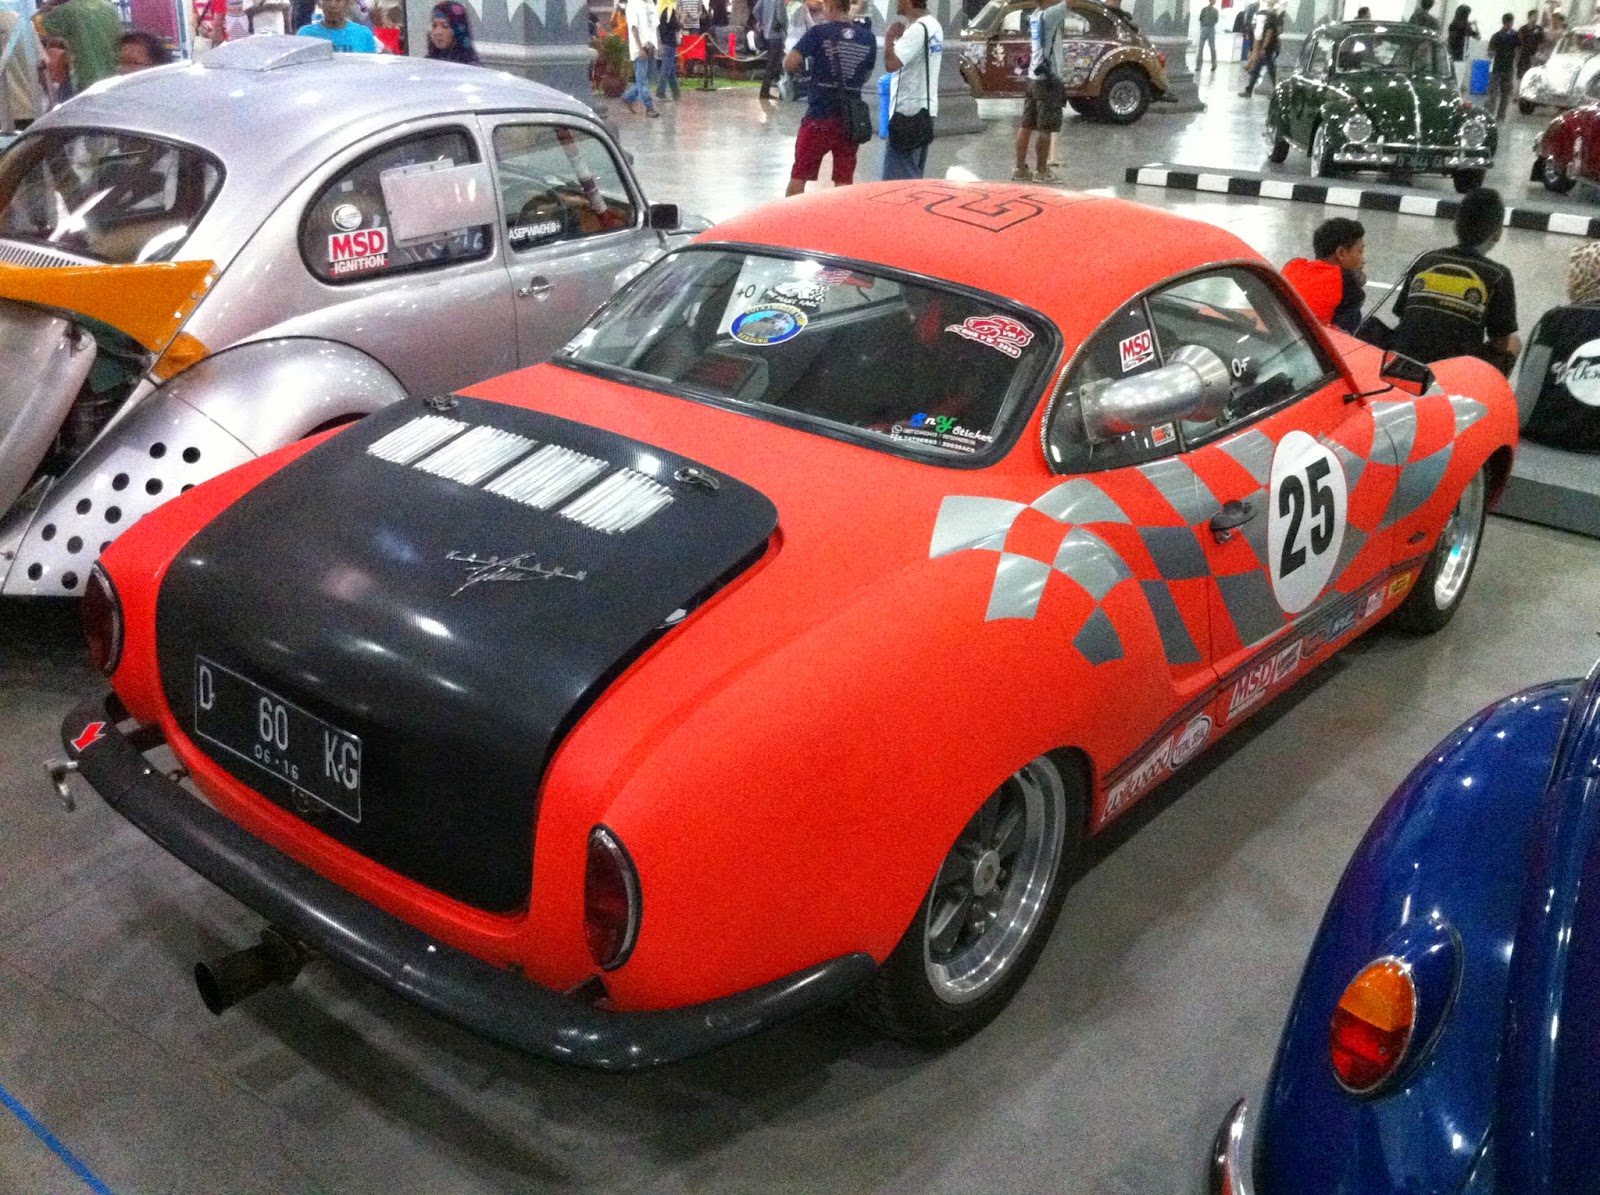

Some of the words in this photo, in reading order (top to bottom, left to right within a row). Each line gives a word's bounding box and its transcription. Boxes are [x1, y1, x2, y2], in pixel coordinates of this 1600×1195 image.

[332, 230, 385, 261] MSD
[334, 254, 385, 275] IGNITION
[1122, 332, 1151, 362] MSD
[1278, 456, 1335, 581] 25
[1232, 657, 1275, 707] MSD
[200, 665, 214, 711] D
[259, 696, 289, 752] 60
[324, 730, 359, 790] KG
